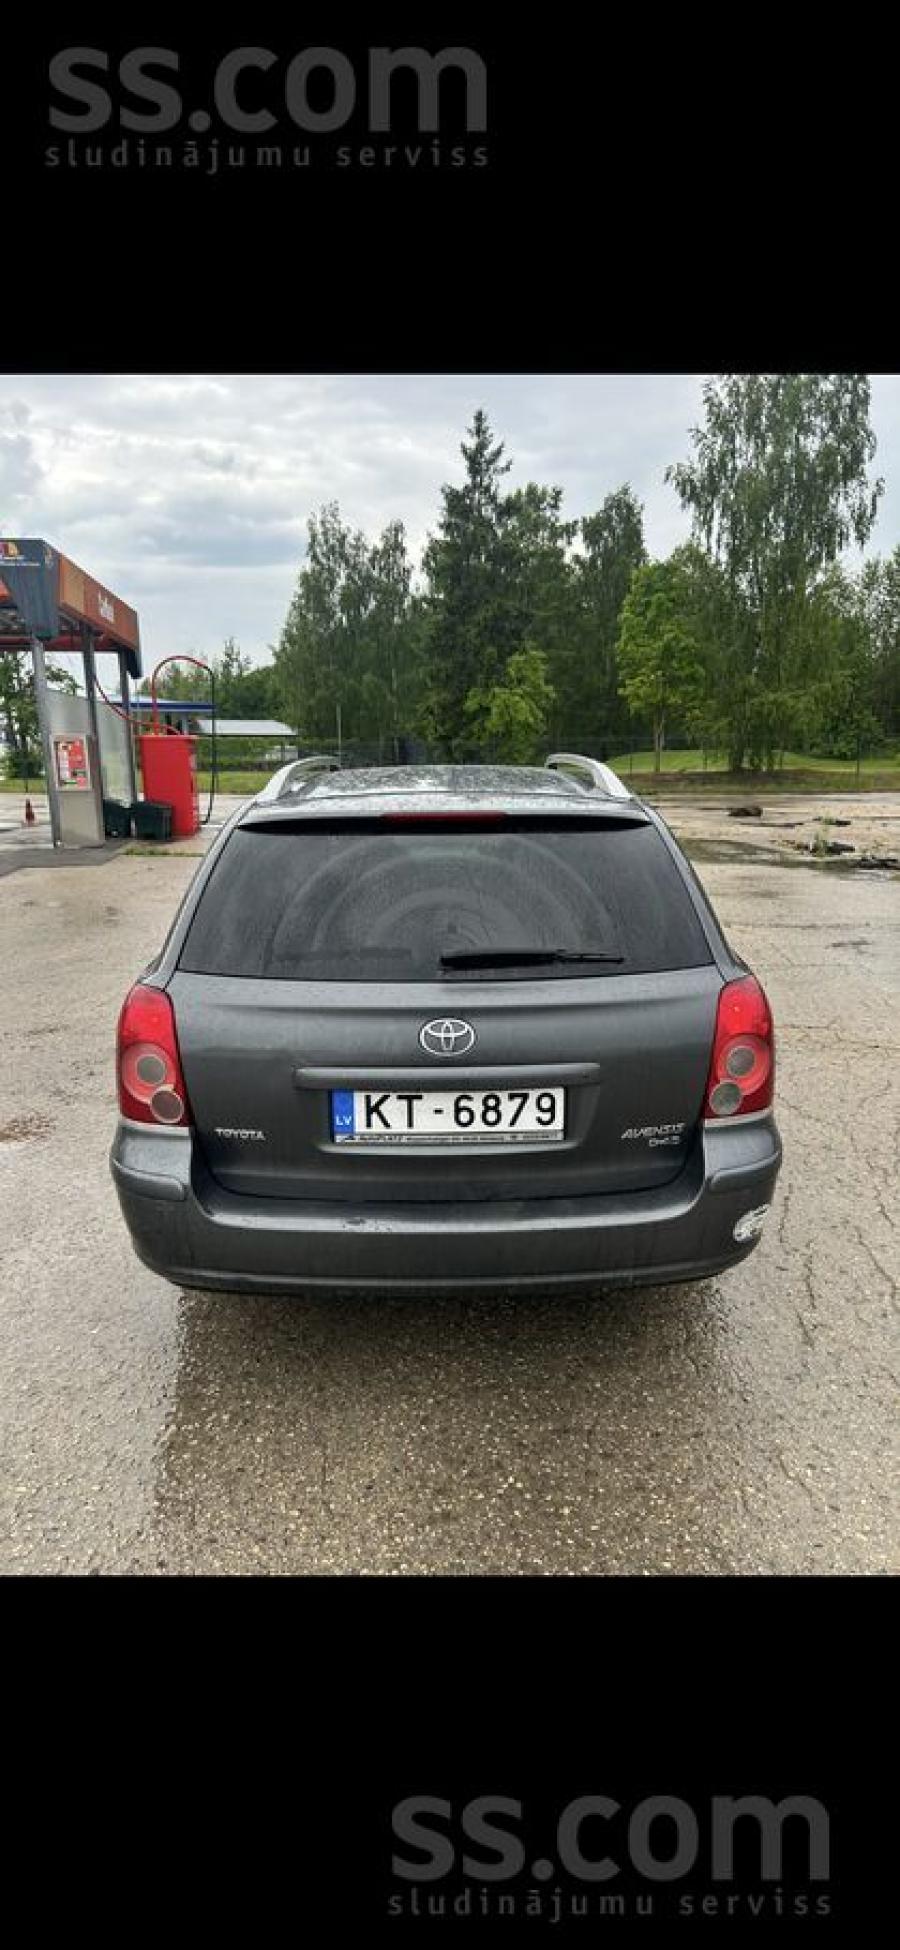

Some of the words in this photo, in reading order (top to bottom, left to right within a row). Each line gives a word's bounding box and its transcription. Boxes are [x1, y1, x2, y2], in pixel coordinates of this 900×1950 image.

[364, 1093, 556, 1129] KT-6879
[336, 1115, 352, 1126] LV
[214, 1127, 266, 1140] TOYOTA
[620, 1123, 685, 1139] AVENSIS
